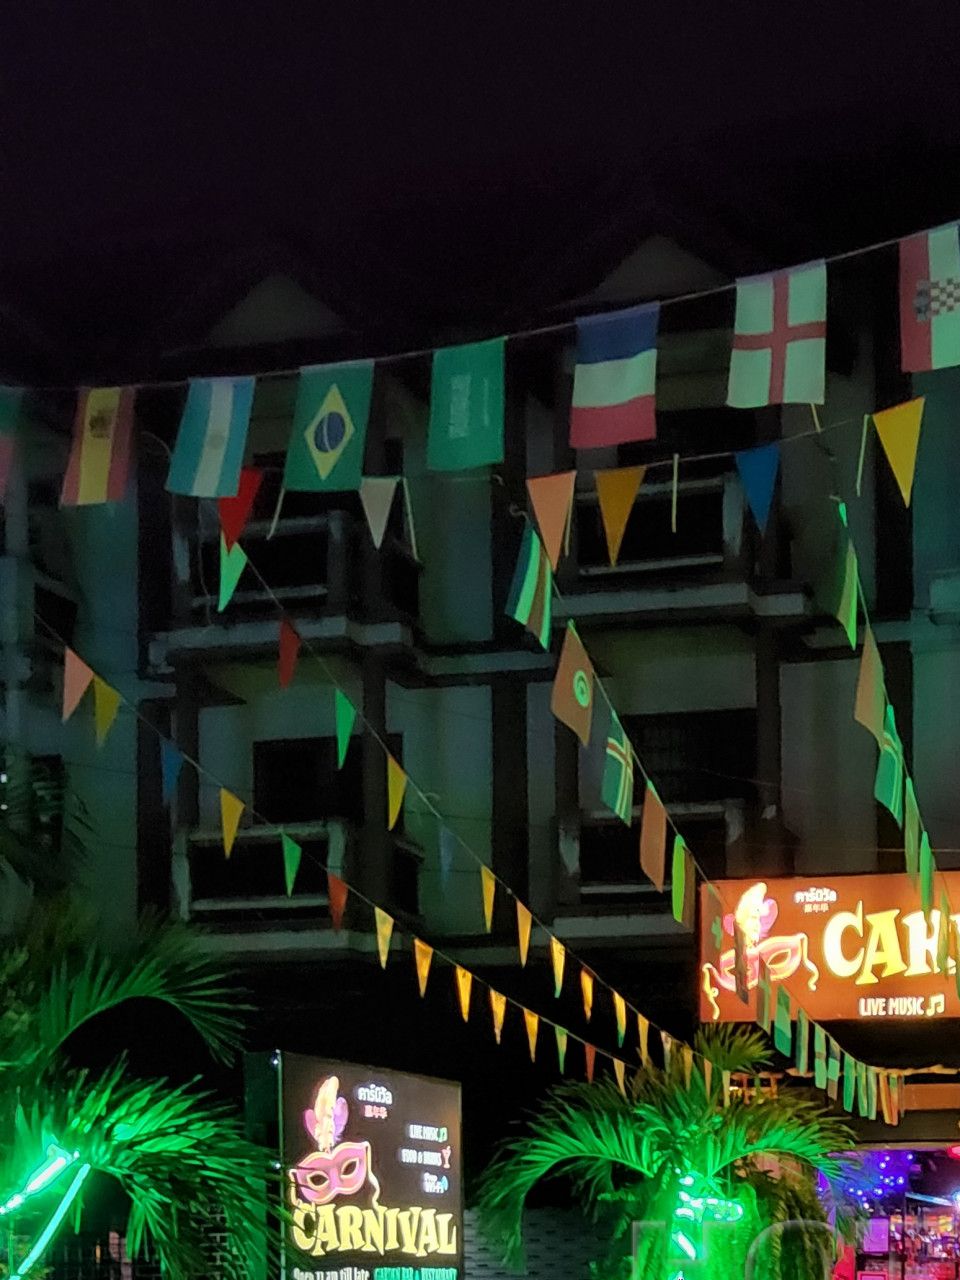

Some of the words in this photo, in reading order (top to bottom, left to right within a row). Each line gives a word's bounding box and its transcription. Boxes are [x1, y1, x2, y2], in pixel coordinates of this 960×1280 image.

[859, 998, 886, 1016] LIVE
[888, 996, 924, 1015] MUSIC
[292, 1203, 457, 1257] CARNIVAL
